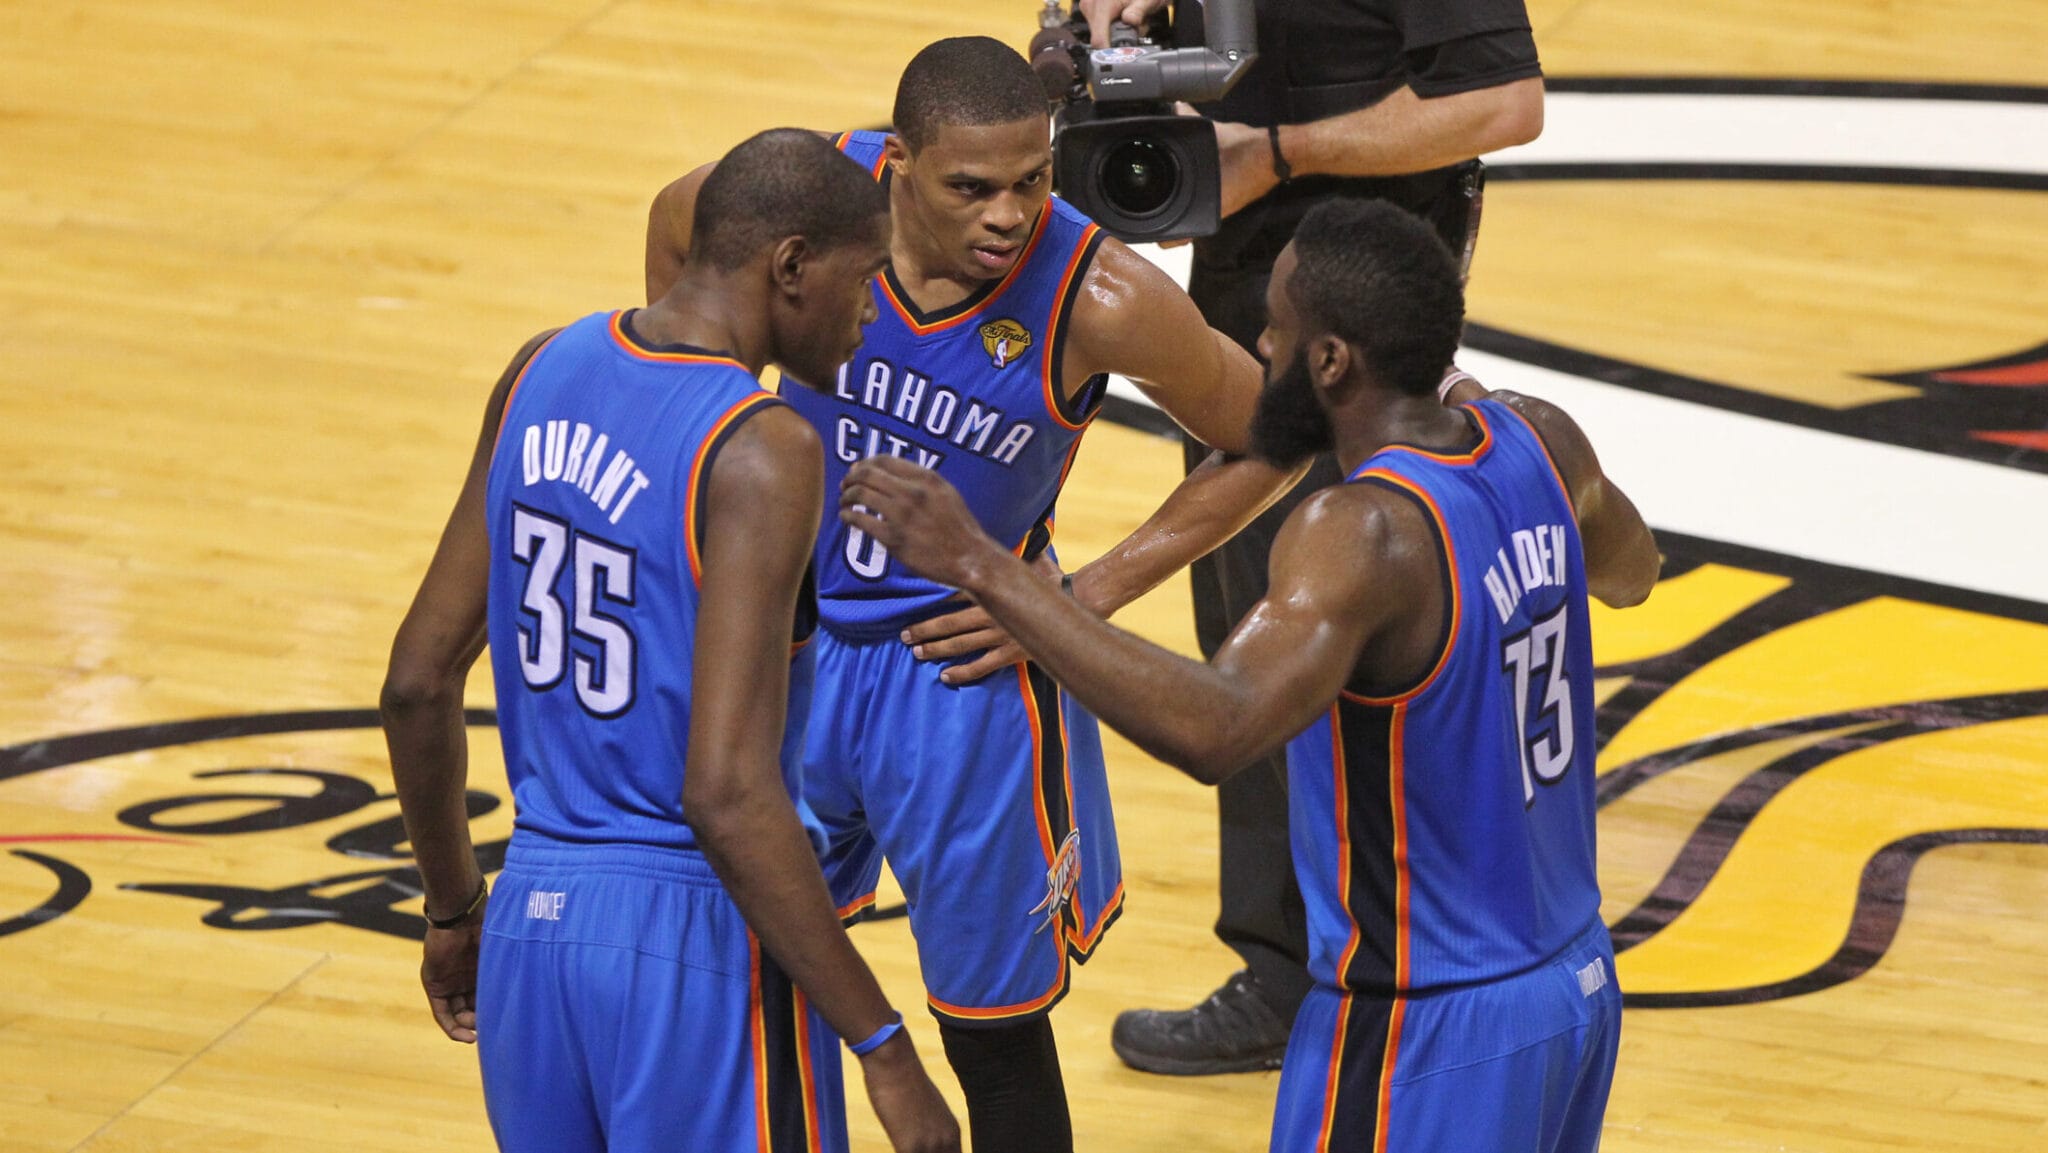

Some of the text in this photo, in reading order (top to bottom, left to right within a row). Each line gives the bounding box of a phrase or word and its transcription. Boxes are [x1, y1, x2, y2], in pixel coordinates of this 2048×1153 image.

[835, 359, 1036, 465] LAHOMA
[522, 419, 650, 525] DURANT
[511, 501, 637, 719] 35
[1483, 524, 1567, 625] HADEN
[1503, 599, 1574, 810] 13
